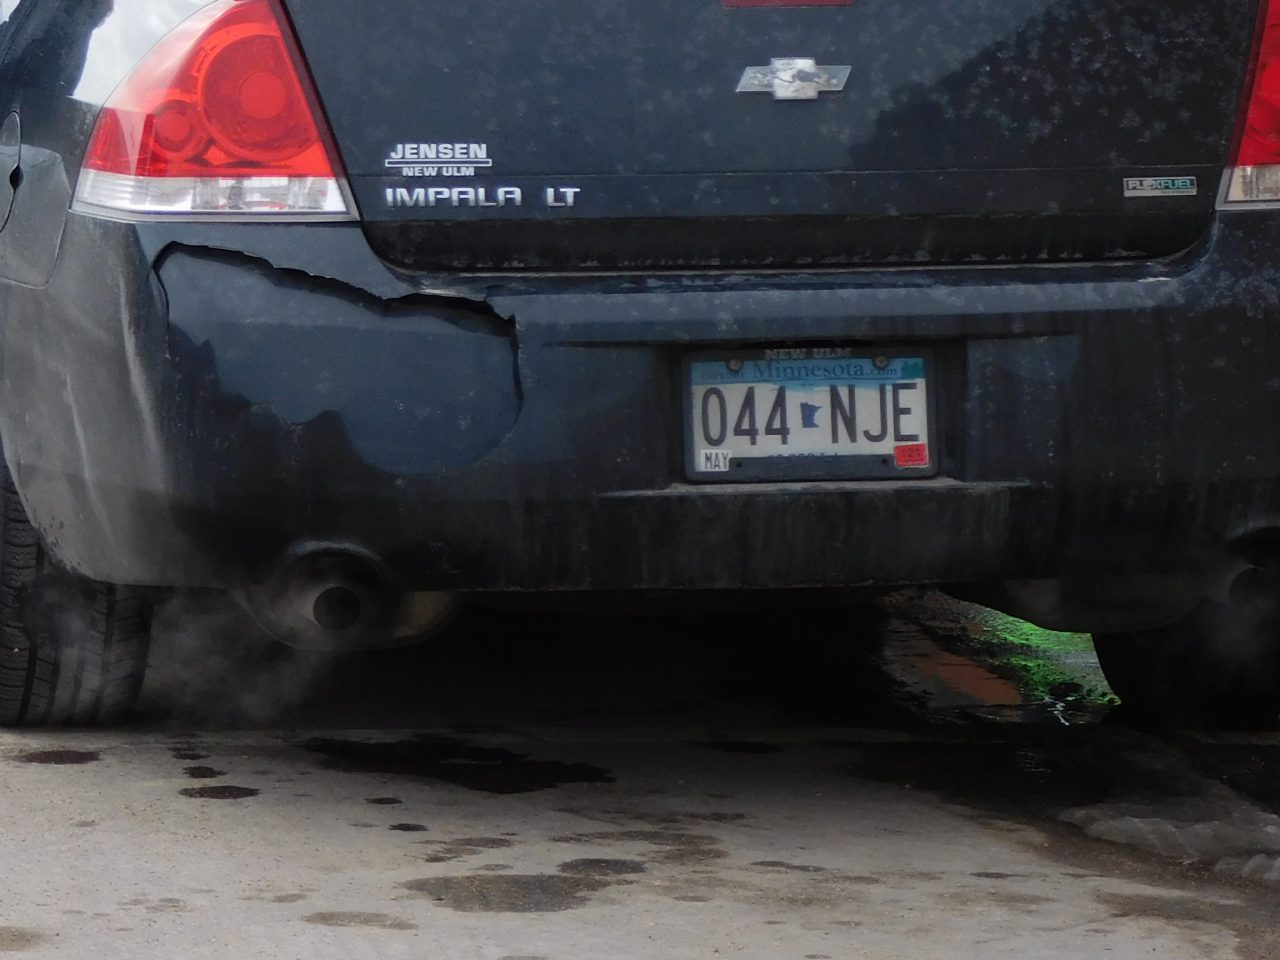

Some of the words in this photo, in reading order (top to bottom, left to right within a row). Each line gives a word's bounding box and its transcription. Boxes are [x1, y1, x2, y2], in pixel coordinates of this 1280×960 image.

[390, 143, 488, 159] JENSEN
[402, 167, 438, 176] NEW
[442, 167, 475, 176] ULM
[386, 187, 523, 207] IMPALA
[546, 187, 581, 207] LT
[764, 347, 808, 360] NEW
[811, 347, 853, 359] ULM
[701, 385, 791, 446] 044
[829, 382, 920, 443] NJE
[704, 451, 729, 470] MAY
